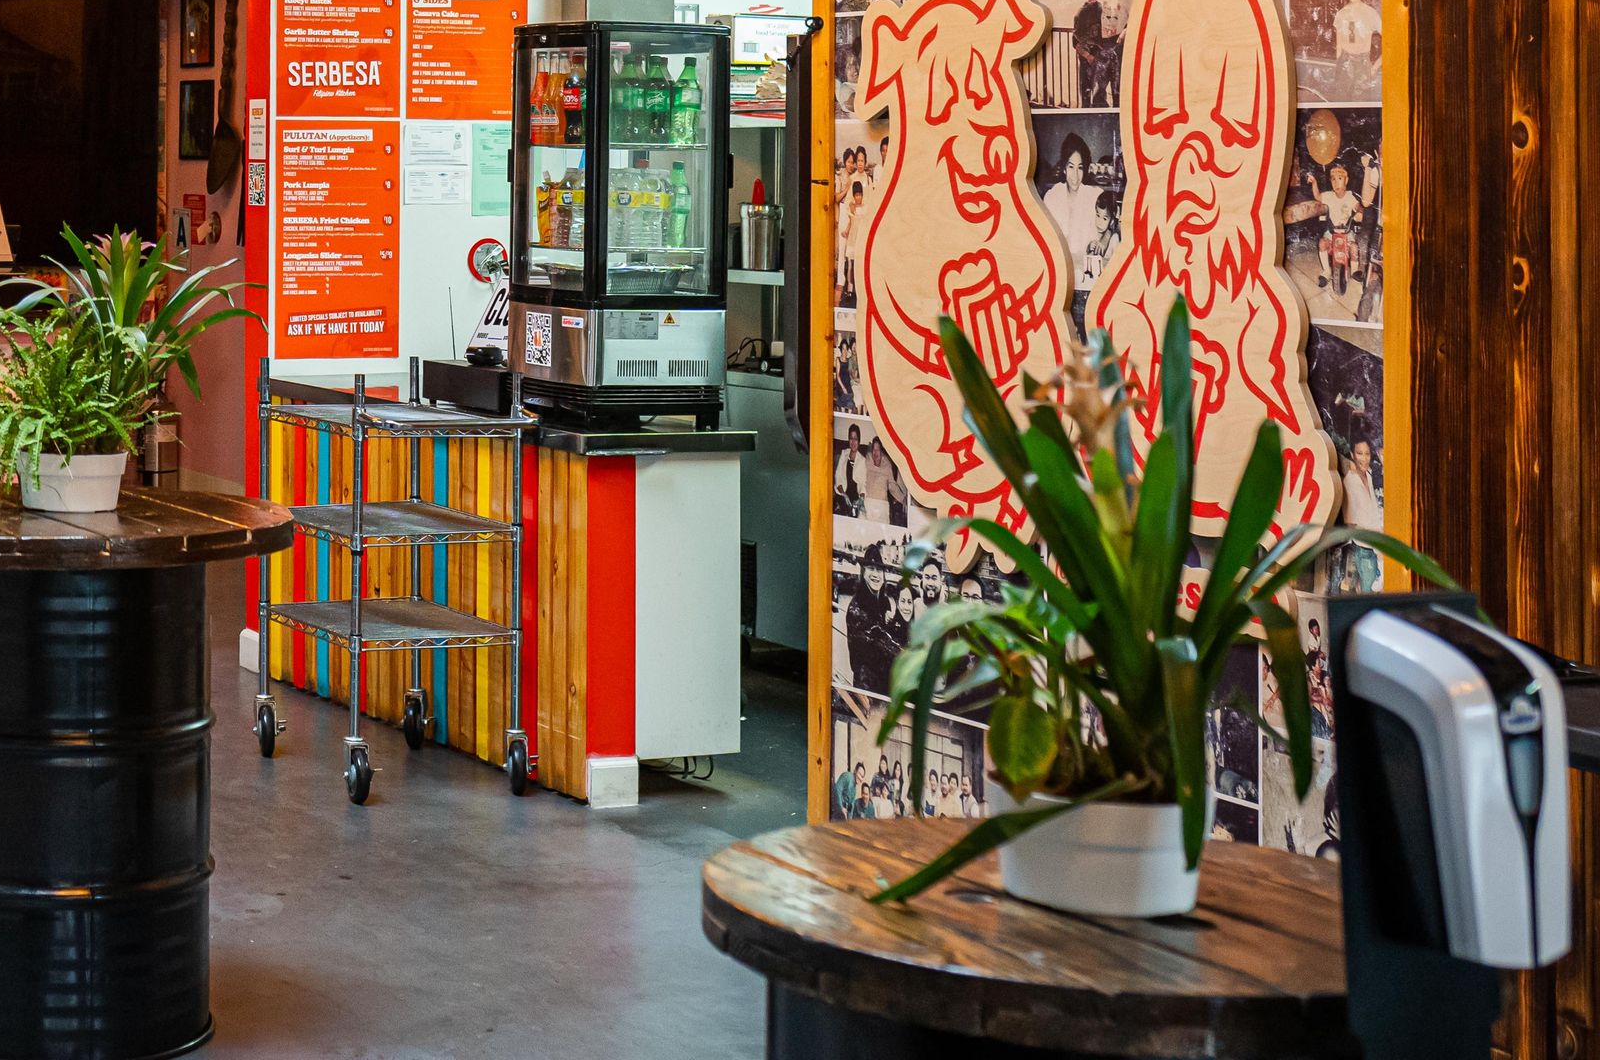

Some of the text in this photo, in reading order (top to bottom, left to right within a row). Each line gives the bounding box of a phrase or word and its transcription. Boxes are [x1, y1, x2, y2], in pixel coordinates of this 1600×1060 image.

[441, 10, 460, 18] Cake
[284, 28, 306, 36] Garlic
[288, 61, 381, 87] SERBESA
[284, 132, 328, 140] PULUTAN
[283, 181, 301, 189] Pork
[290, 314, 307, 322] LIMITED
[308, 312, 328, 321] SPECIALS
[328, 311, 348, 320] SUBJECT
[287, 321, 385, 336] ASK IF WE HAVE IT TODAY
